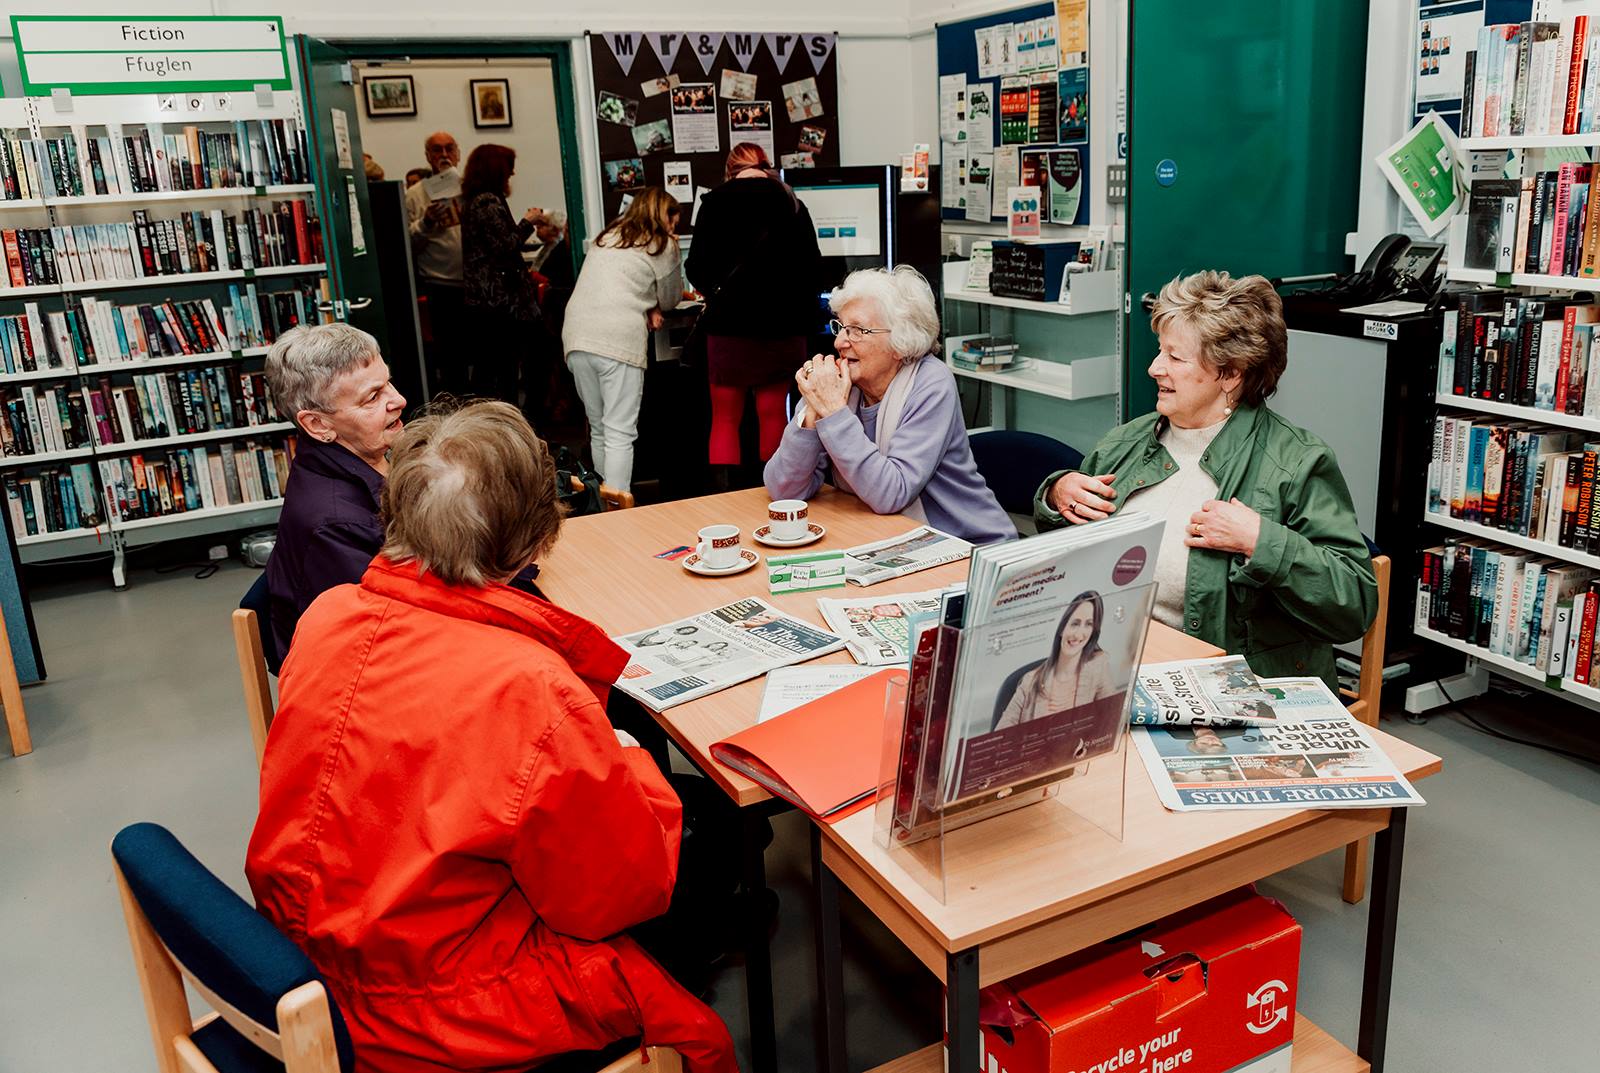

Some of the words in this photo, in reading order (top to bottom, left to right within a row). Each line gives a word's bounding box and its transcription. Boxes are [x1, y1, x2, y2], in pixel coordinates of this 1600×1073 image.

[121, 25, 185, 41] Fiction
[698, 34, 715, 56] &
[125, 56, 192, 77] Ffuglen
[190, 98, 200, 109] O
[218, 98, 227, 108] P
[1567, 76, 1577, 116] PICOULT
[1561, 166, 1571, 181] IAN
[1535, 178, 1544, 199] NIGHT
[1558, 183, 1570, 214] RANKIN
[1506, 203, 1514, 213] R
[1533, 199, 1542, 225] HUNTER
[1503, 247, 1510, 256] R
[1530, 323, 1540, 357] MICHAEL
[1526, 358, 1536, 390] RIDPATH
[1434, 420, 1443, 434] NORA
[1444, 422, 1453, 437] NORA
[1457, 425, 1466, 439] NORA
[1432, 435, 1441, 460] ROBERTS
[1443, 438, 1453, 463] ROBERTS
[1456, 440, 1465, 464] ROBERTS
[1473, 443, 1482, 465] ROBERTS
[1570, 462, 1576, 470] IN
[1583, 451, 1595, 478] PETER
[1534, 464, 1545, 488] LILA
[1577, 481, 1592, 526] ROBINSON
[1032, 571, 1067, 589] medical
[1497, 562, 1506, 592] CHRIS
[1524, 570, 1532, 601] CHRIS
[995, 587, 1045, 607] treatment?
[1511, 581, 1520, 607] CHRIS
[1494, 594, 1502, 620] RYAN
[1521, 602, 1530, 630] RYAN
[1558, 612, 1566, 622] S
[1509, 608, 1518, 631] RYAN
[750, 627, 809, 654] Guardian
[772, 627, 793, 639] The
[1553, 653, 1561, 663] S
[1276, 722, 1307, 735] in!
[1286, 727, 1360, 743] pickle
[1313, 721, 1350, 732] are
[1242, 733, 1278, 744] we
[1277, 742, 1294, 752] a
[1305, 738, 1370, 752] What
[1190, 788, 1280, 805] TIMES
[1285, 786, 1397, 803] MATURE
[1069, 1048, 1136, 1073] cycle
[1139, 1027, 1182, 1064] your
[1152, 1048, 1193, 1073] here
